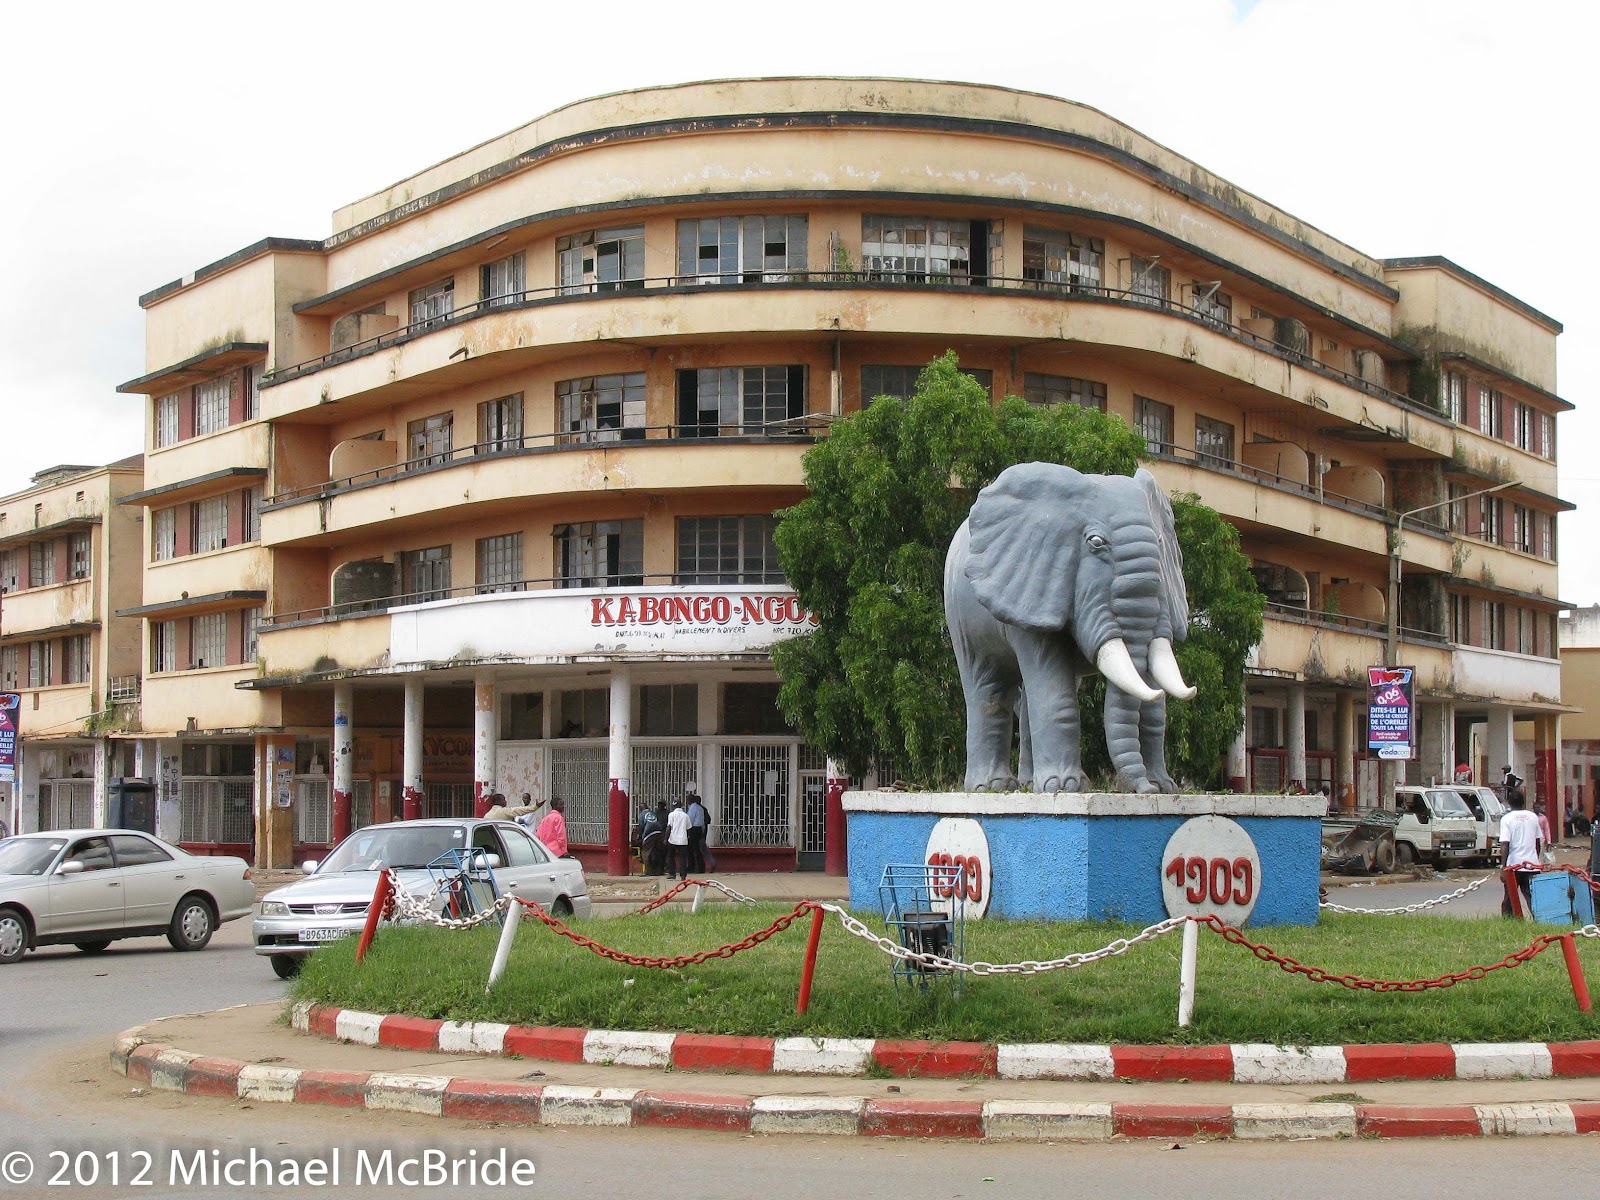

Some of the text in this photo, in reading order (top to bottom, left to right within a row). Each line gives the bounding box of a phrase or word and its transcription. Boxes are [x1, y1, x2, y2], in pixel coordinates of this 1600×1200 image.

[722, 626, 746, 634] DIVERS
[1166, 857, 1253, 905] 1909
[306, 929, 337, 940] 8963AC
